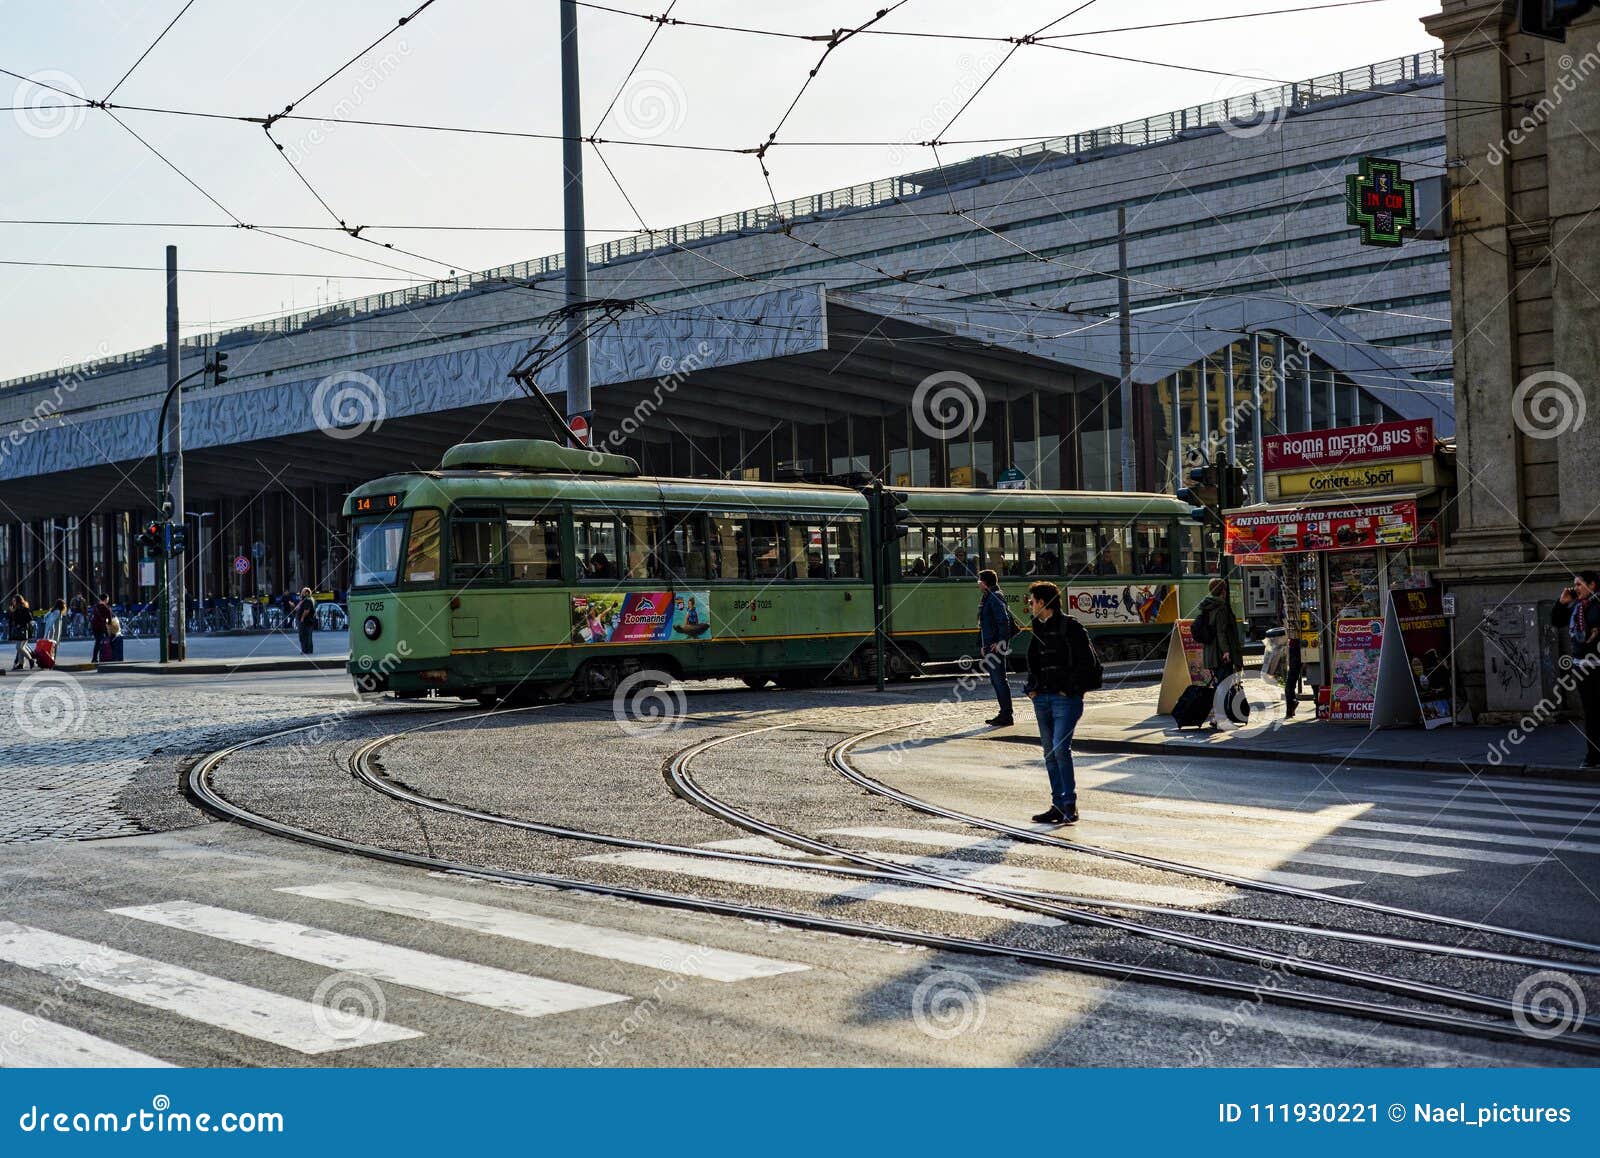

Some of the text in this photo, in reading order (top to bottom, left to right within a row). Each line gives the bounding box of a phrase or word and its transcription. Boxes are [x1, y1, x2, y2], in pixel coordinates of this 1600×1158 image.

[1283, 429, 1411, 455] ROMA METRO BUS
[1329, 449, 1344, 457] MAP
[1349, 446, 1366, 455] PLAN
[1309, 475, 1350, 491] Corriere
[1364, 469, 1394, 486] Sport
[357, 498, 371, 510] 14
[1236, 505, 1394, 527] INFORMATION AND TICKET HERE
[365, 602, 384, 612] 7025
[625, 613, 666, 624] Zoomarine
[1095, 608, 1108, 619] 6-9
